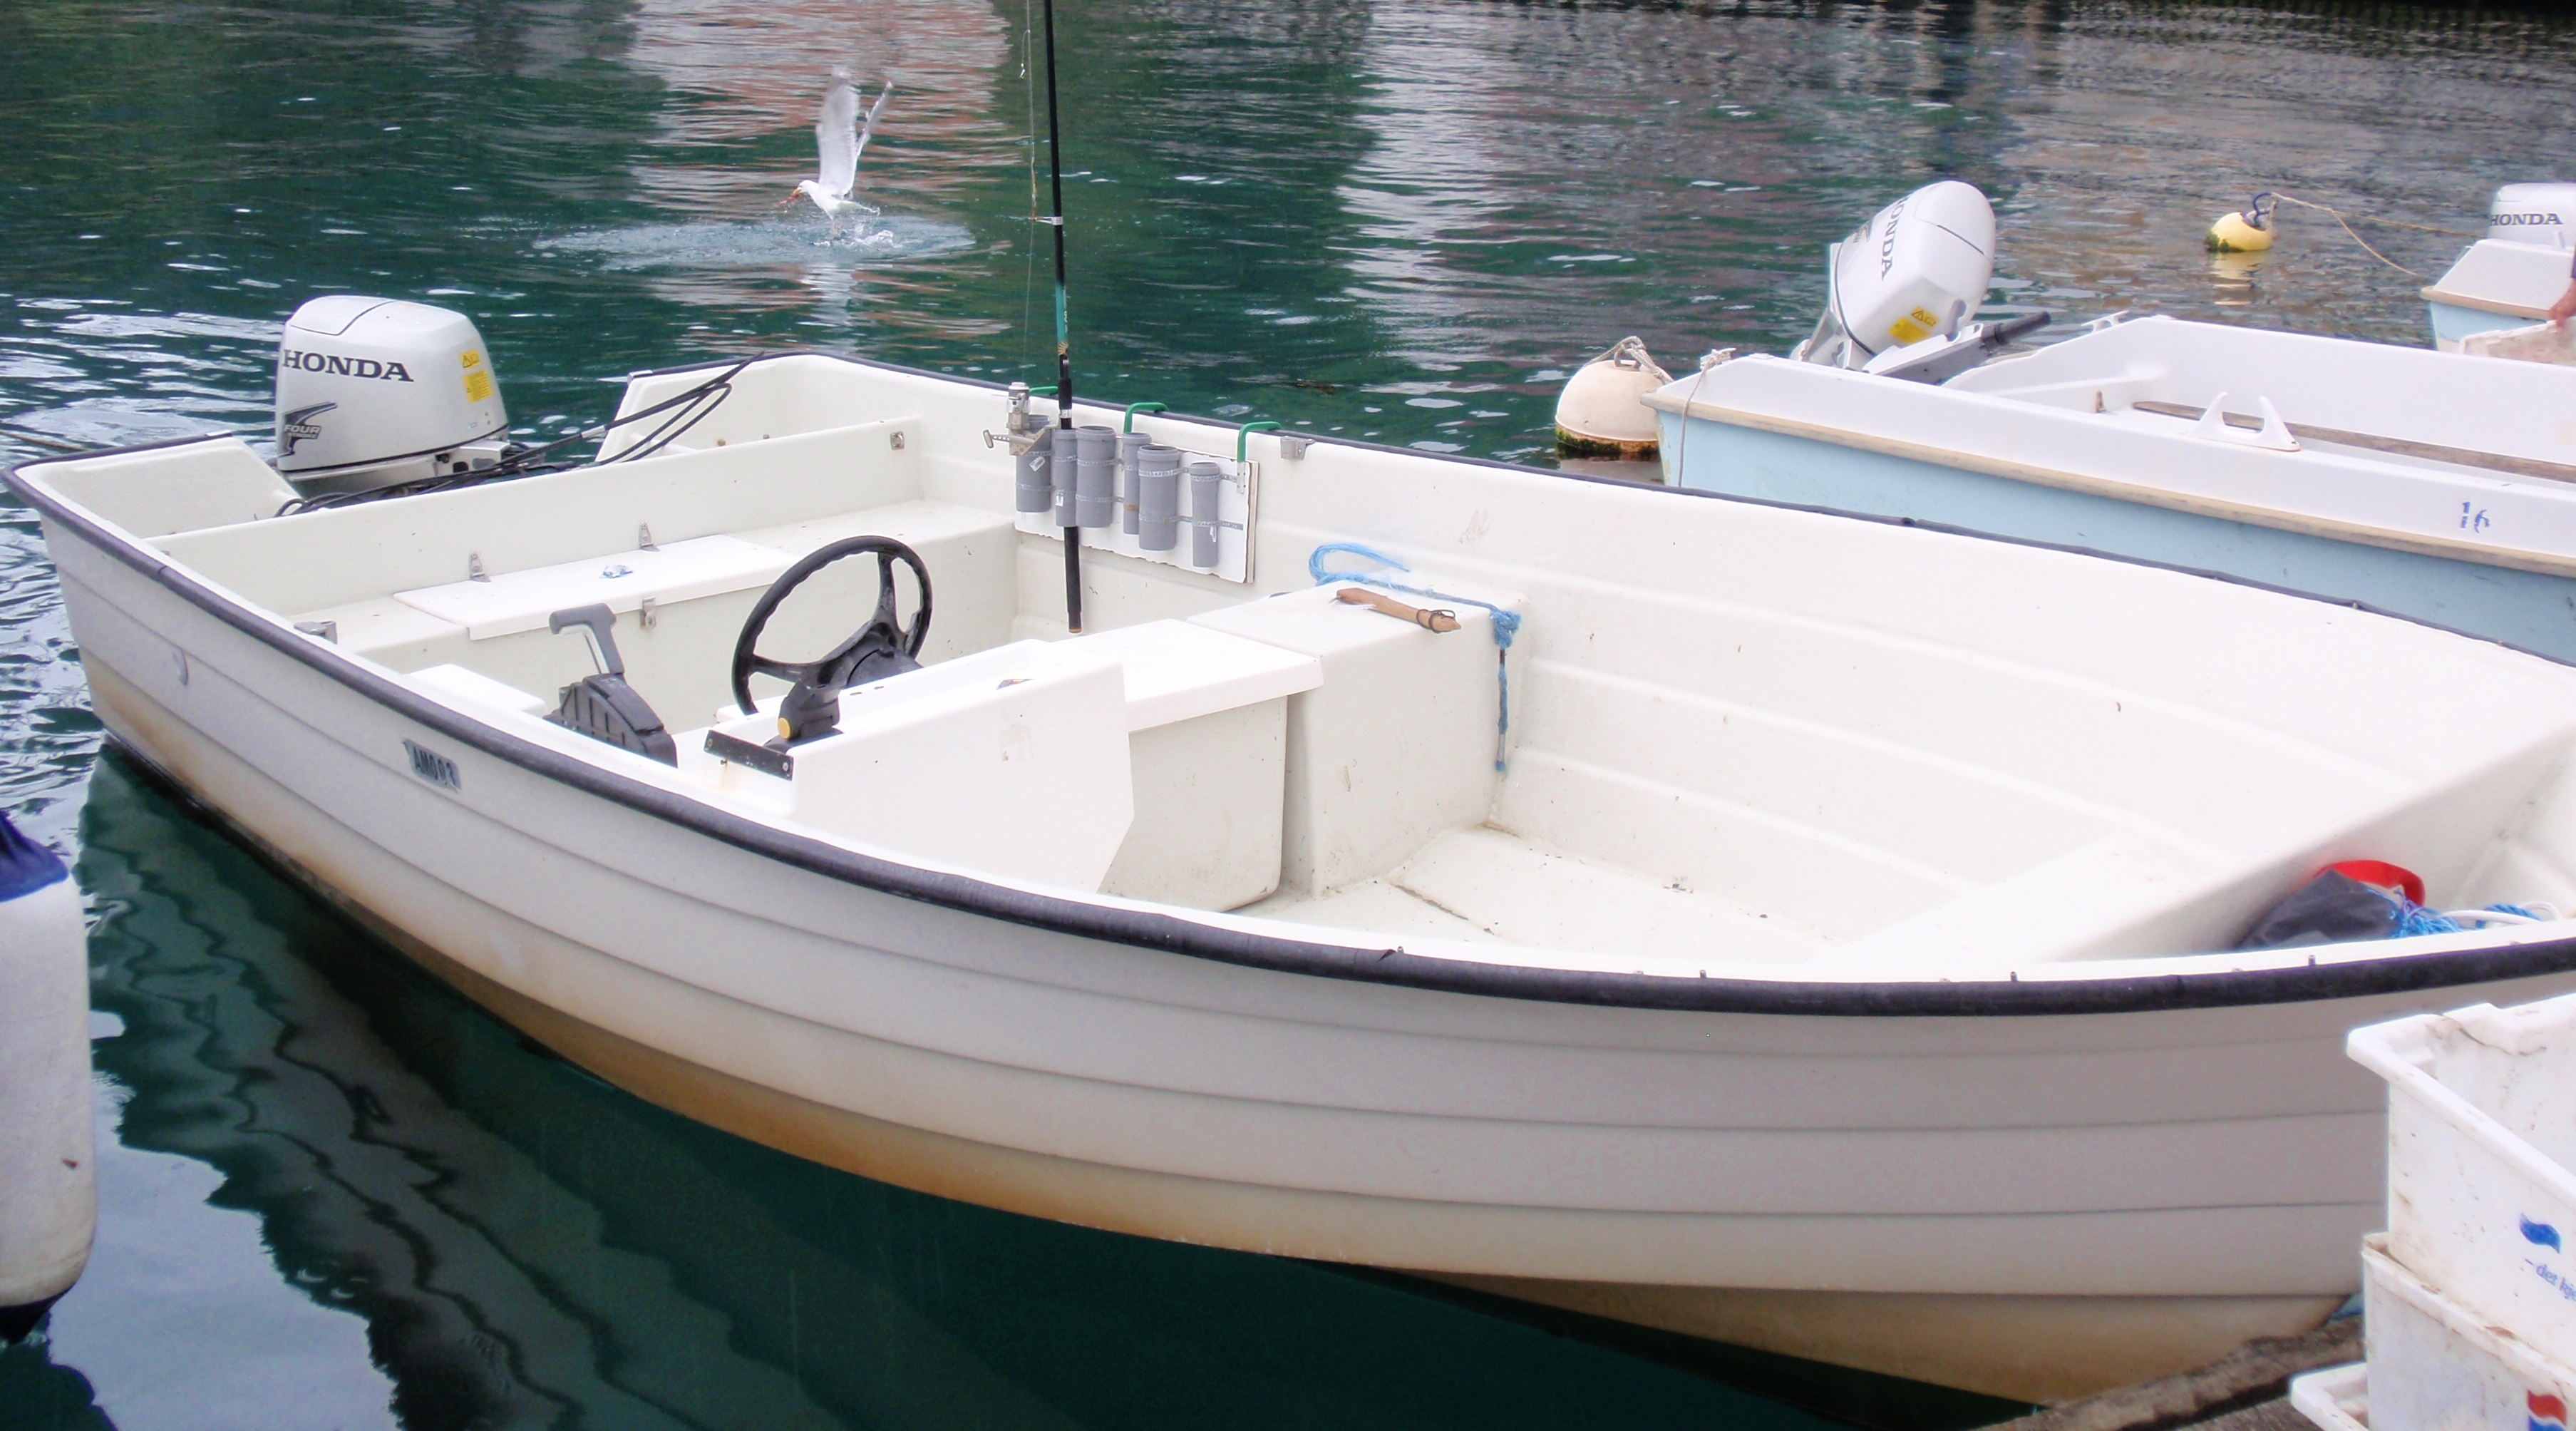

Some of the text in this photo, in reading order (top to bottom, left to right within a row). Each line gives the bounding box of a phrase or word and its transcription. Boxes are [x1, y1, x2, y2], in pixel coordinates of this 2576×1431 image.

[2490, 213, 2564, 226] HONDA
[282, 349, 414, 383] HONDA
[284, 424, 320, 434] FOUR
[2461, 501, 2490, 533] 16
[2536, 1264, 2557, 1286] det
